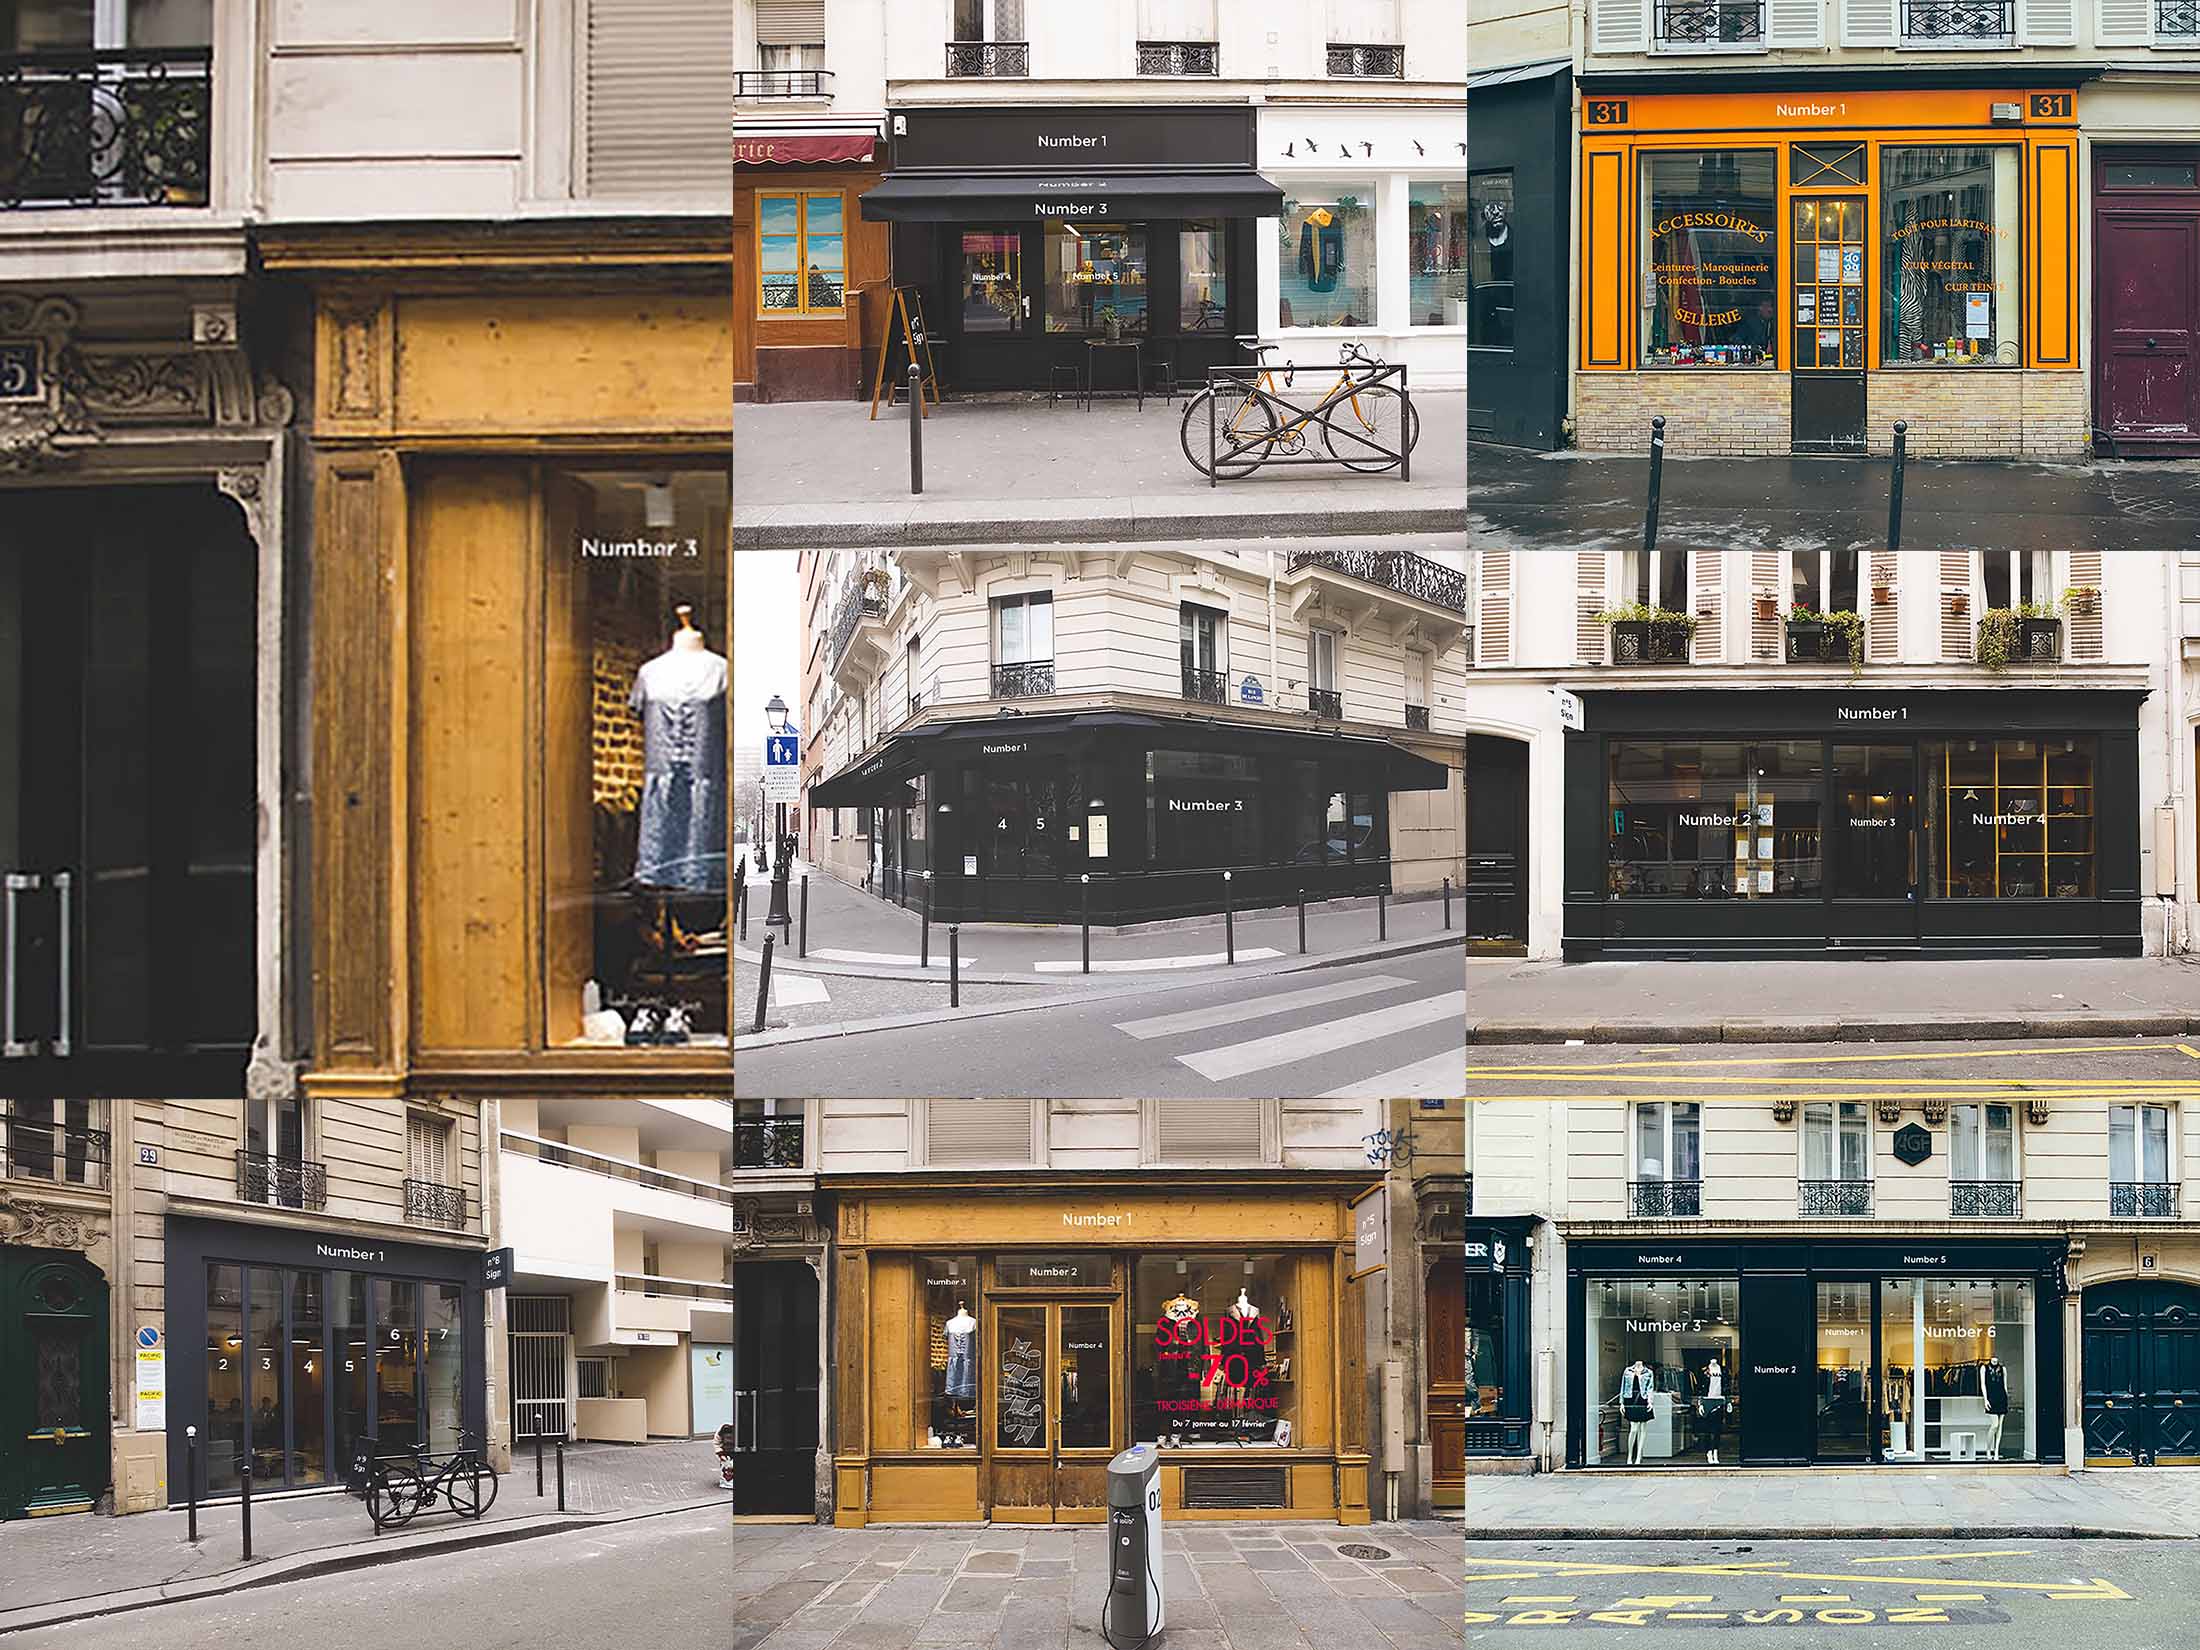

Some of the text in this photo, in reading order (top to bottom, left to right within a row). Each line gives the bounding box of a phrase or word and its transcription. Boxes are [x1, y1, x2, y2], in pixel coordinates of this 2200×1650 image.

[1776, 103, 1846, 116] Number 1
[2039, 96, 2064, 116] 31
[1596, 102, 1622, 124] 31
[1038, 134, 1107, 147] Number 1
[1035, 202, 1108, 215] Number 3
[1648, 212, 1768, 244] ACCESSOIRES
[1891, 223, 1919, 241] TOUT
[1920, 219, 1948, 231] POUR
[1702, 262, 1769, 274] Maroquinerie
[972, 272, 1003, 281] Number
[1072, 272, 1110, 280] Number
[1719, 275, 1757, 286] Boucles
[1674, 308, 1742, 326] SELLERIE
[582, 539, 698, 557] Number 3
[1560, 708, 1574, 721] Sign
[1838, 707, 1907, 719] Number 1
[983, 743, 1027, 753] Number 1
[1169, 799, 1243, 811] Number 3
[998, 817, 1008, 830] 4
[1036, 817, 1045, 830] 5
[1680, 813, 1752, 826] Number 2
[1850, 818, 1896, 827] Number 3
[1972, 813, 2046, 825] Number 4
[142, 1148, 157, 1163] 29
[1063, 1212, 1132, 1226] Number 1
[1360, 1231, 1377, 1246] Sign
[316, 1244, 385, 1262] Number 1
[1638, 1255, 1682, 1263] Number 4
[1903, 1255, 1947, 1264] Number 5
[2145, 1257, 2152, 1267] 6
[1029, 1267, 1078, 1276] Number 2
[927, 1278, 959, 1286] Number
[1155, 1316, 1273, 1346] SOLDES
[1626, 1319, 1701, 1332] Number 3
[1922, 1325, 1997, 1338] Number 6
[390, 1329, 400, 1340] 6
[440, 1329, 448, 1340] 7
[1825, 1328, 1864, 1336] Number 1
[218, 1359, 228, 1370] 2
[262, 1358, 271, 1370] 3
[303, 1360, 313, 1373] 4
[345, 1361, 354, 1372] 5
[1754, 1365, 1797, 1374] Number 2
[1192, 1420, 1216, 1429] janvier
[1232, 1420, 1239, 1428] 17
